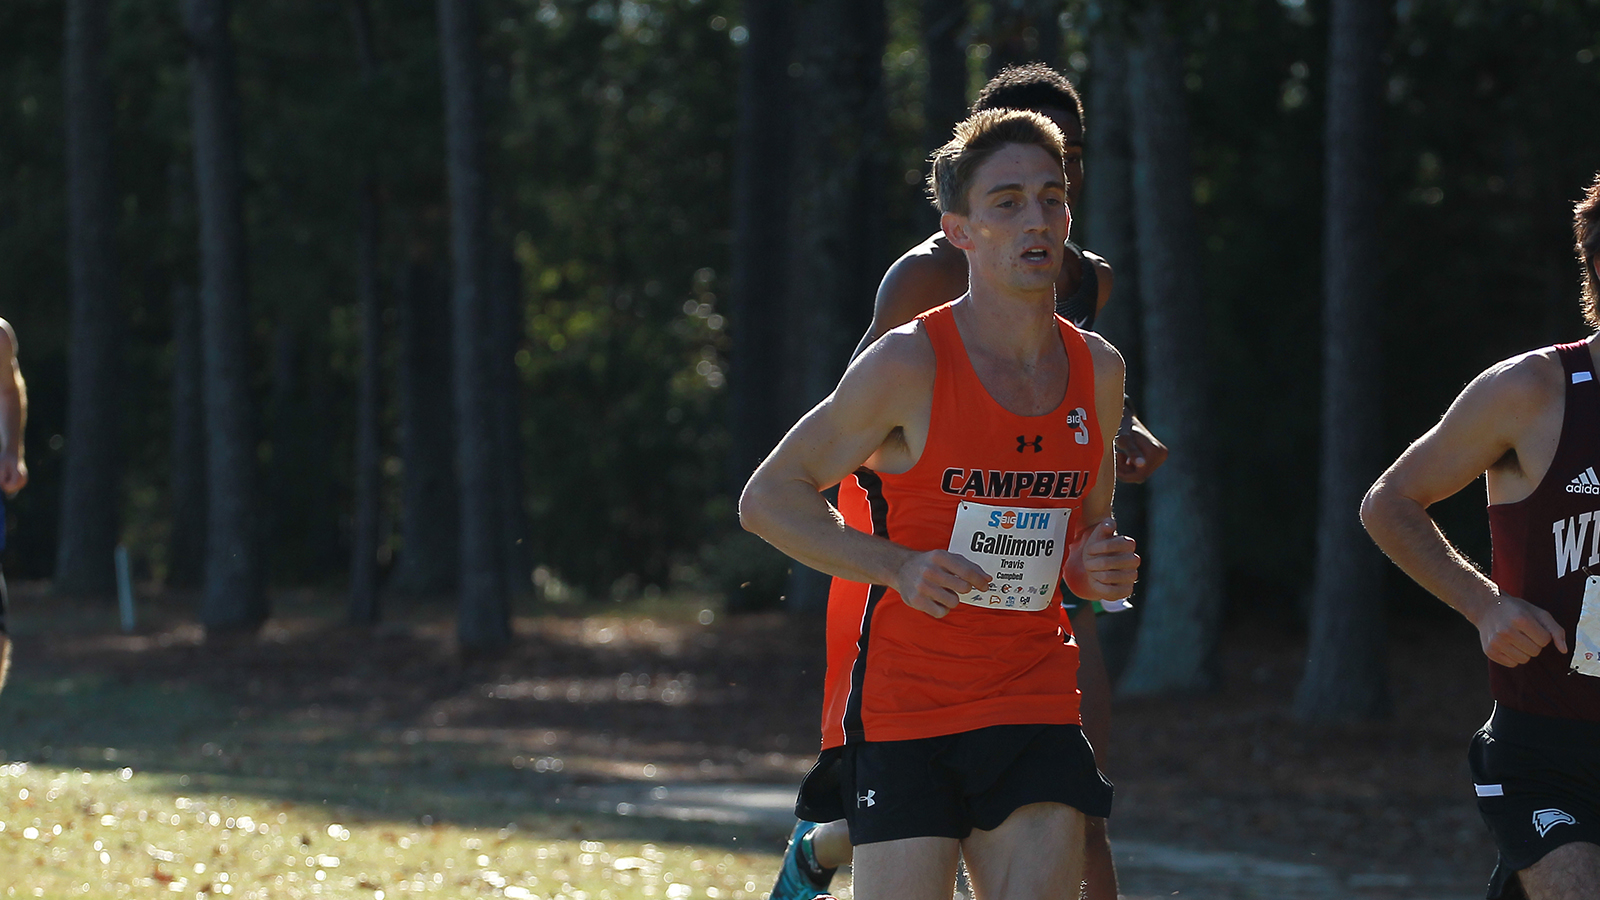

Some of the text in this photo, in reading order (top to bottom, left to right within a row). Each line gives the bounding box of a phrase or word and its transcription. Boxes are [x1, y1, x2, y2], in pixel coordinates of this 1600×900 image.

[1066, 415, 1081, 424] BIG
[970, 531, 1055, 557] Gallimore
[1000, 559, 1025, 570] Travis
[996, 571, 1024, 581] Campbell
